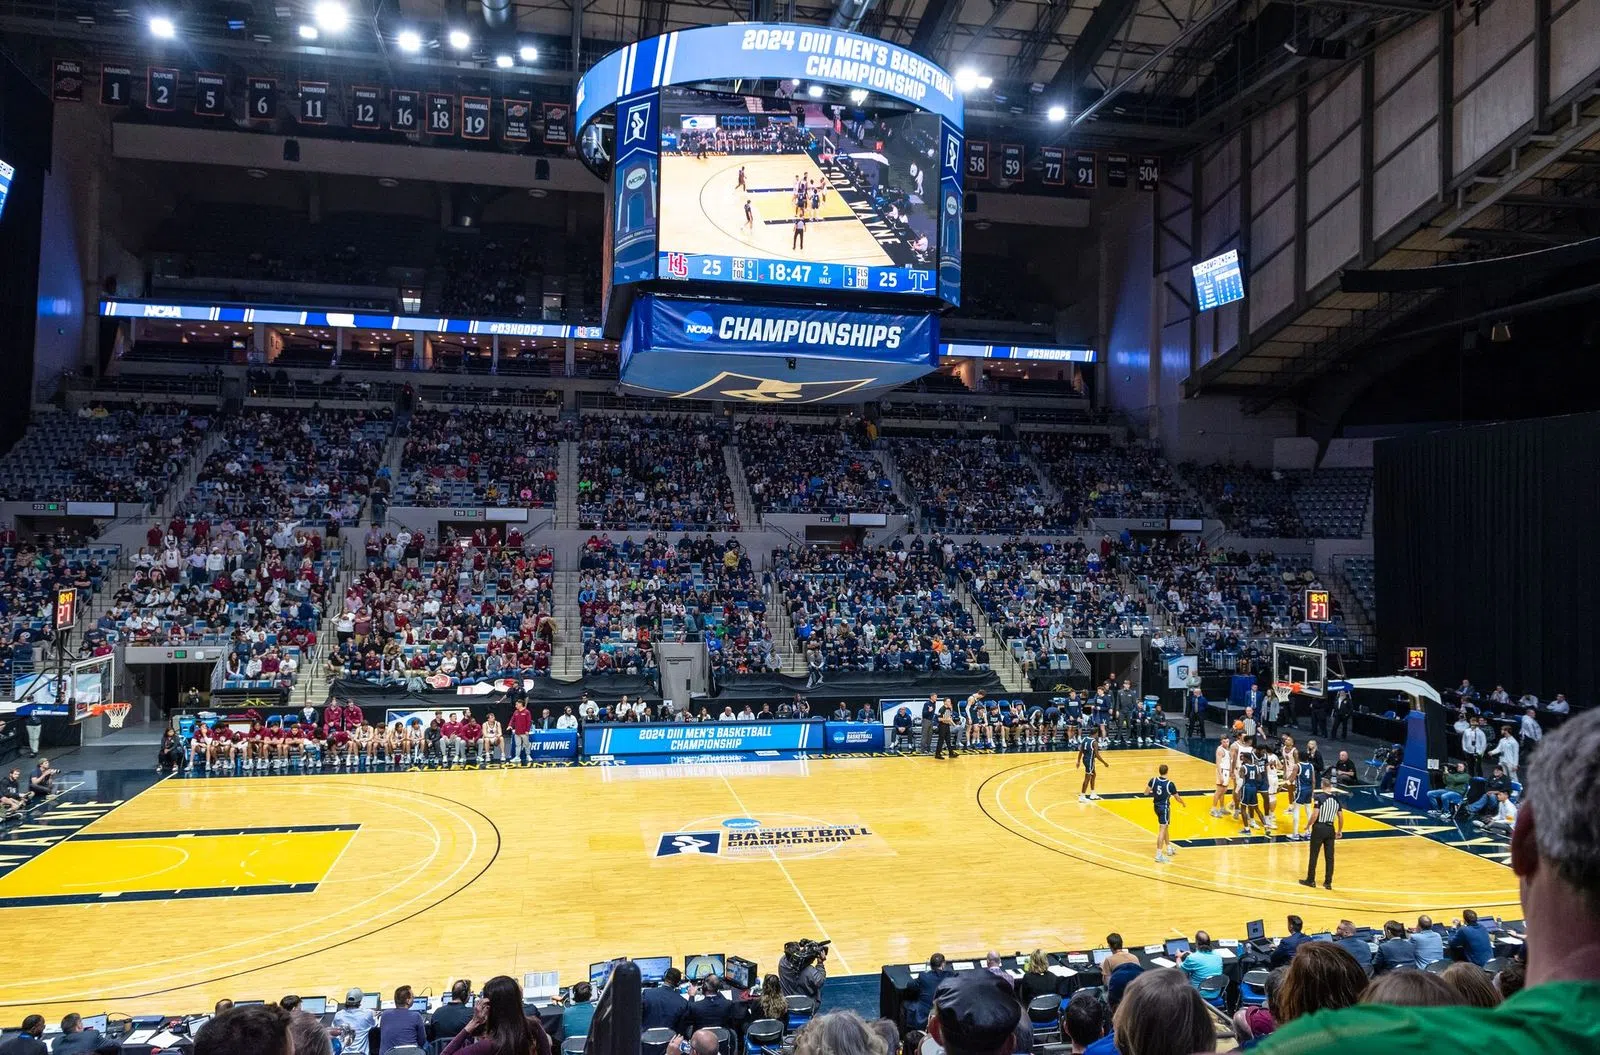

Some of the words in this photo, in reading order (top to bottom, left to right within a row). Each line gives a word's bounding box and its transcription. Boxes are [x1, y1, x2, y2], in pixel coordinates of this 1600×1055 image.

[742, 30, 795, 50] 2024
[798, 32, 832, 54] DIII
[834, 36, 888, 66] MEN'S
[890, 50, 954, 101] BASKETBALL
[806, 56, 926, 100] CHAMPIONSHIP
[112, 82, 120, 100] 1
[156, 86, 168, 104] 2
[205, 92, 216, 108] 5
[257, 97, 268, 114] 6
[305, 100, 322, 118] 11
[356, 104, 374, 122] 12
[397, 108, 413, 126] 16
[432, 111, 449, 129] 18
[465, 116, 485, 134] 19
[970, 156, 985, 172] 58
[1005, 160, 1020, 175] 59
[1046, 163, 1060, 178] 77
[1078, 168, 1094, 184] 91
[1139, 166, 1158, 182] 504
[848, 200, 902, 245] WAYNE
[702, 260, 722, 275] 25
[733, 260, 744, 268] FLS
[748, 260, 754, 268] 0
[822, 266, 828, 276] 2
[857, 268, 868, 276] FLS
[733, 270, 744, 278] TOL
[748, 271, 752, 279] 3
[768, 263, 812, 282] 18:47
[880, 272, 898, 288] 25
[857, 278, 868, 286] TOL
[908, 270, 928, 292] T
[144, 304, 182, 318] NCAA
[490, 323, 544, 336] #D3HOOPS
[590, 328, 600, 336] 25
[686, 324, 713, 335] NCAA
[718, 316, 902, 349] CHAMPIONSHIPS
[58, 604, 70, 624] 27
[1311, 603, 1326, 618] 27
[1411, 658, 1421, 666] 27
[639, 730, 665, 740] 2024
[667, 728, 682, 739] DIII
[685, 728, 714, 738] MEN'S
[717, 726, 772, 738] BASKETBALL
[543, 741, 570, 750] WAYNE
[670, 739, 742, 750] CHAMPIONSHIP
[485, 761, 574, 769] COUNTY
[793, 752, 898, 760] MEMORIAL
[1304, 768, 1310, 779] 4
[1156, 784, 1162, 795] 5
[728, 828, 872, 840] BASKETBALL
[728, 836, 851, 846] CHAMPIONSHIP
